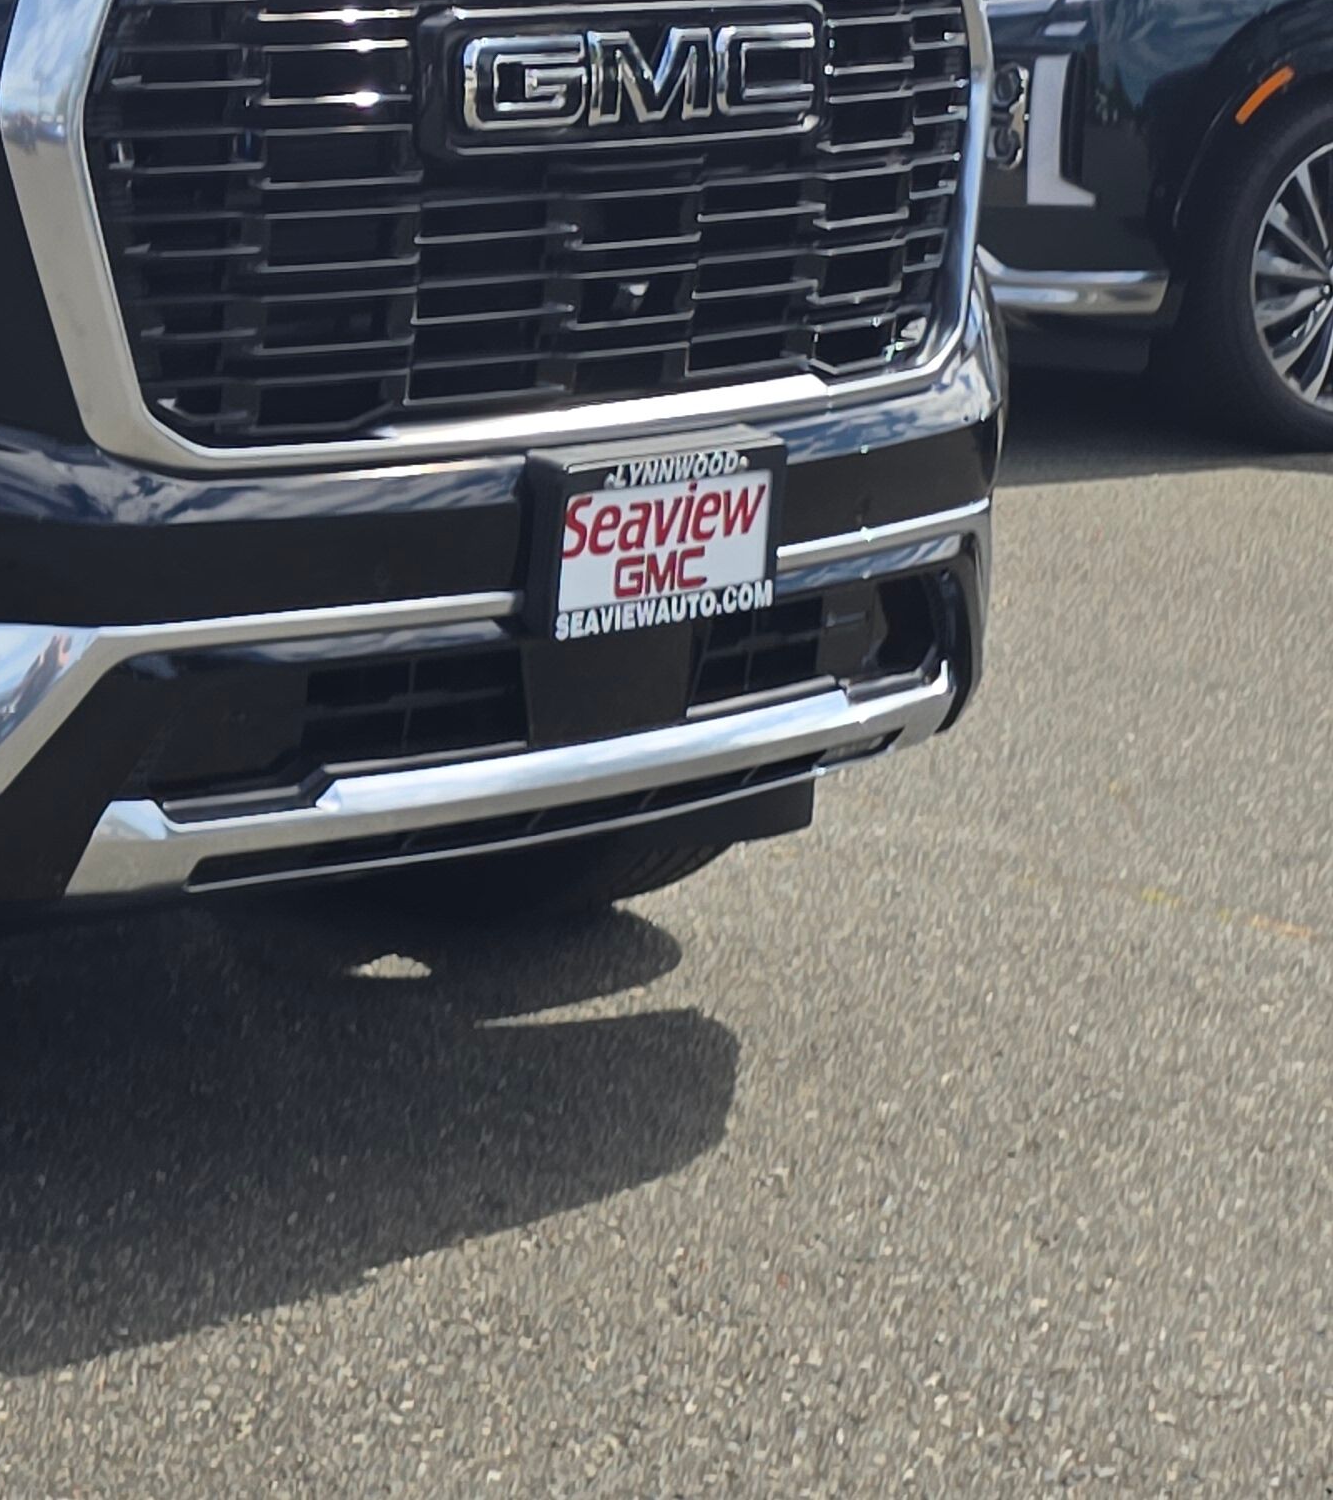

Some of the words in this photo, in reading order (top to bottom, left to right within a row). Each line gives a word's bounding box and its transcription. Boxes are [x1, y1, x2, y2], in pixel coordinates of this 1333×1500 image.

[463, 23, 816, 131] GMC
[614, 450, 739, 488] LYNNWOOD
[562, 482, 767, 560] Seaview
[614, 546, 708, 600] GMC
[554, 579, 774, 642] SEAVIEWAUTO.COM
